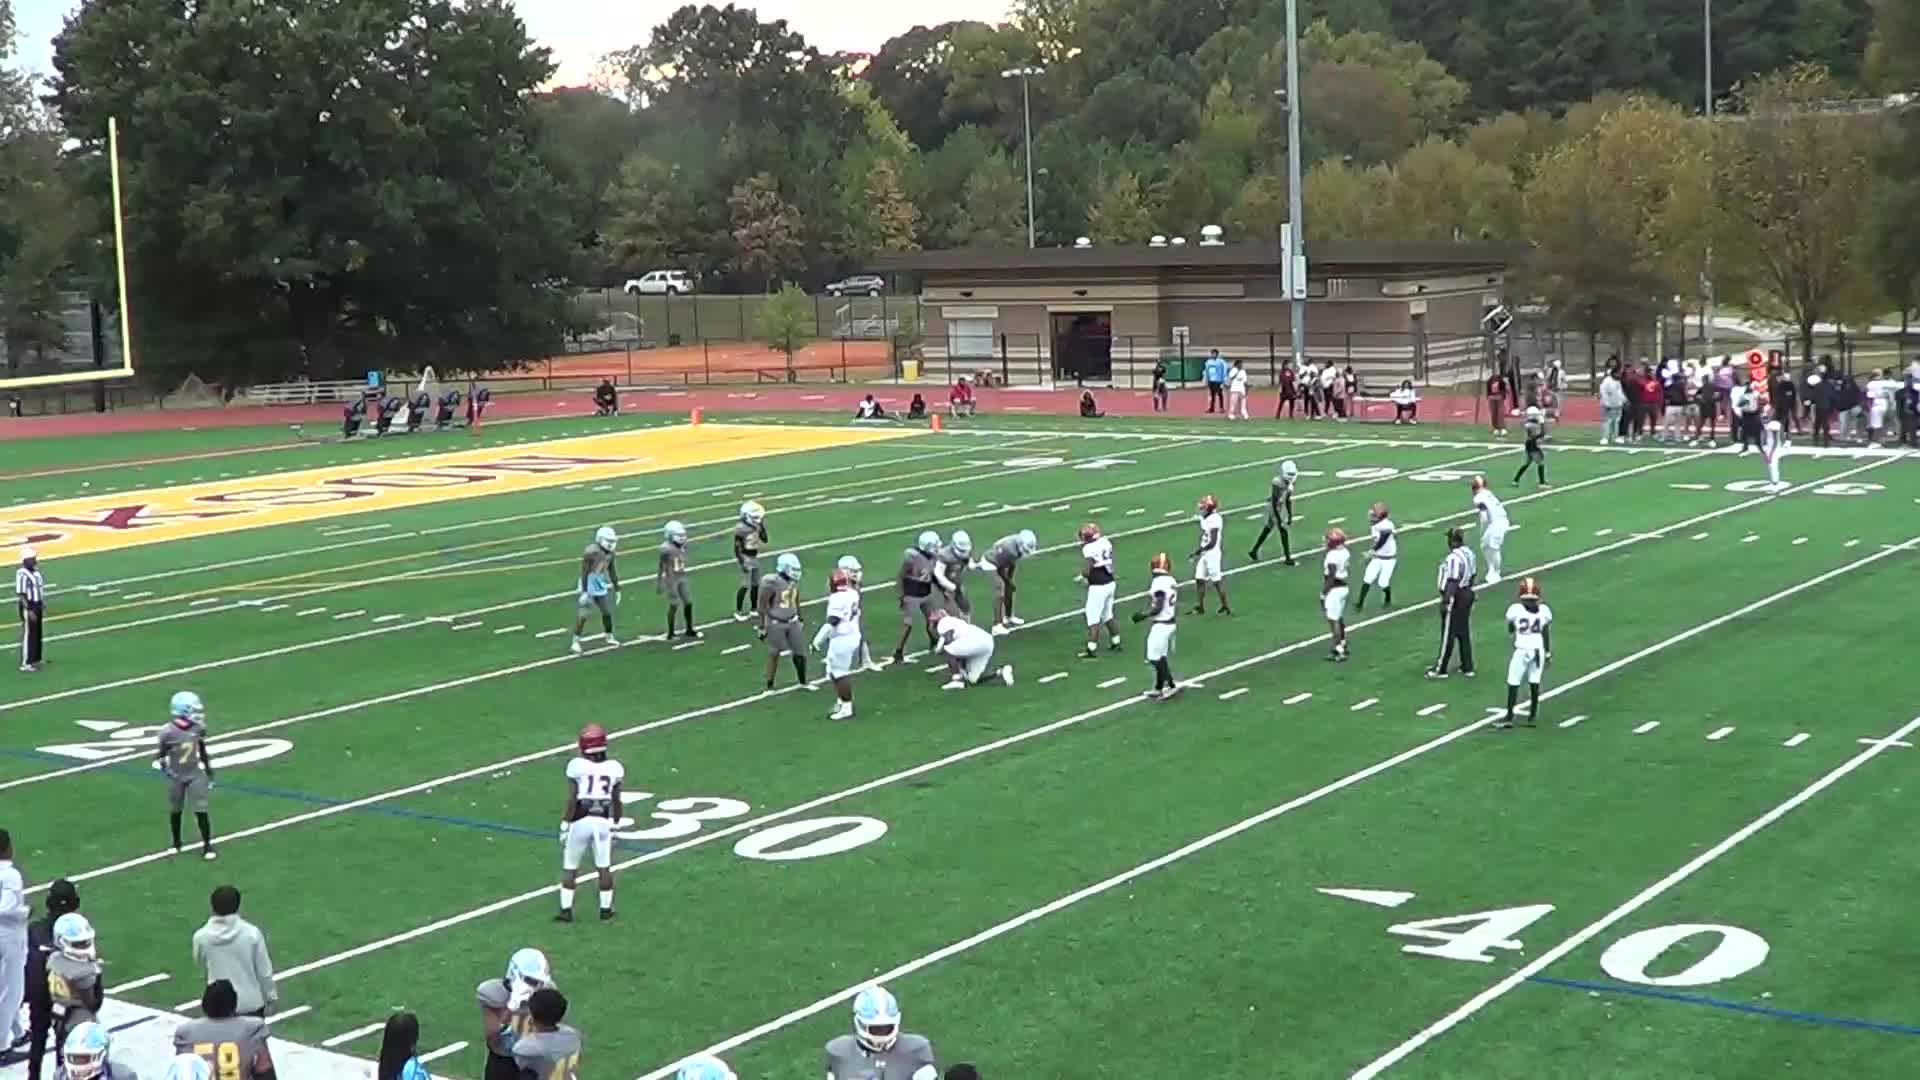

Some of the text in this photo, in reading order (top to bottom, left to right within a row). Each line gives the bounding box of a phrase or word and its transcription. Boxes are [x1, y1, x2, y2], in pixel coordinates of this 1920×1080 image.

[1519, 617, 1541, 634] 24
[178, 741, 193, 764] 7
[587, 774, 612, 794] 13
[611, 796, 888, 860] 30
[1386, 904, 1770, 986] 40
